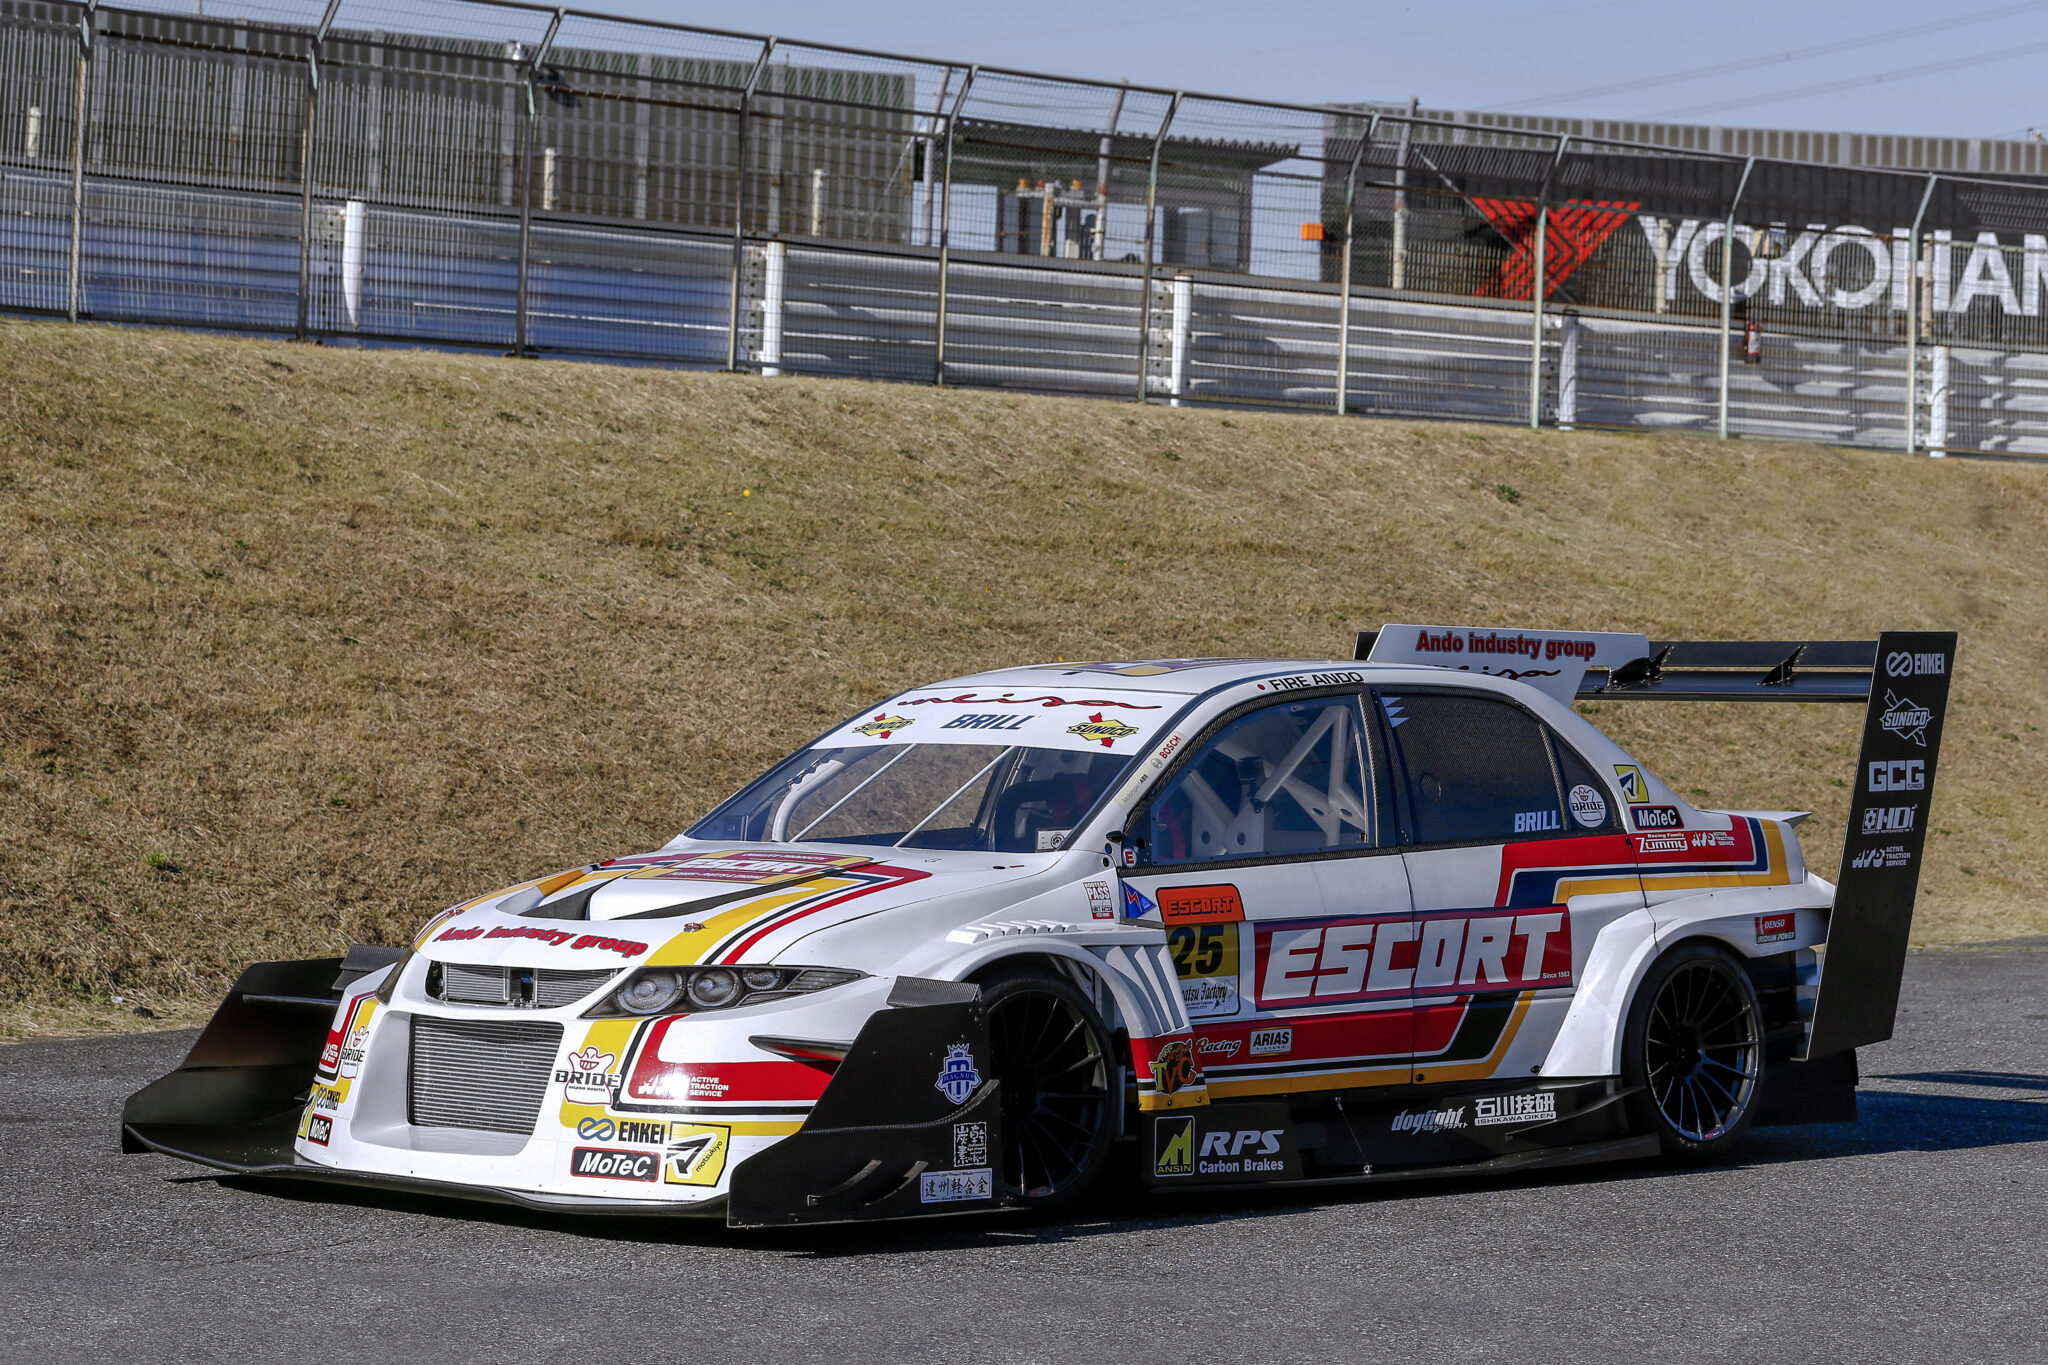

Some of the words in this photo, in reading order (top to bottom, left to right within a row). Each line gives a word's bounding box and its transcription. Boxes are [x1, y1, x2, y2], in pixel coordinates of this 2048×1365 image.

[1416, 630, 1464, 653] Ando
[1468, 632, 1542, 659] industry
[1545, 638, 1596, 662] group
[1914, 653, 1945, 675] ENKEI
[1269, 673, 1312, 691] FIRE
[1311, 671, 1365, 687] ANDO
[940, 713, 1035, 729] BRILL
[1884, 711, 1928, 727] SUNOCO
[1073, 723, 1135, 738] SUNOCO
[1159, 735, 1182, 759] BOSCH
[1869, 760, 1925, 792] GCG
[1571, 800, 1605, 812] BRIDE
[1514, 809, 1560, 833] BRILL
[1638, 808, 1677, 827] MoTeC
[1635, 837, 1688, 853] Zummy
[671, 858, 829, 873] ESCORT
[1125, 851, 1135, 864] E
[1087, 887, 1110, 900] PASS
[1167, 897, 1234, 917] ESCORT
[1765, 919, 1785, 929] DENSO
[432, 926, 485, 942] Ando
[571, 935, 649, 958] group
[1168, 924, 1224, 976] 25
[1262, 912, 1564, 1000] ESCORT
[1197, 1038, 1241, 1058] Racing
[1253, 1031, 1289, 1047] ARIAS
[555, 1070, 620, 1087] BRIDE
[690, 1083, 729, 1091] TRACTION
[942, 1072, 975, 1082] MAGNUS
[1475, 1093, 1554, 1118] 石川技研
[1391, 1106, 1466, 1135] dogfight
[1477, 1115, 1522, 1125] ISHIKAWA
[1524, 1113, 1554, 1121] GIKEN
[309, 1118, 330, 1142] MoTeC
[618, 1121, 666, 1144] ENKEI
[1200, 1130, 1284, 1156] RPS
[579, 1152, 652, 1177] MoTeC
[695, 1140, 723, 1172] matsukiyo
[1200, 1160, 1240, 1173] Carbon
[1244, 1158, 1284, 1171] Brakes
[1157, 1165, 1192, 1174] ANSIN
[925, 1175, 988, 1197] 遠州軽合金
